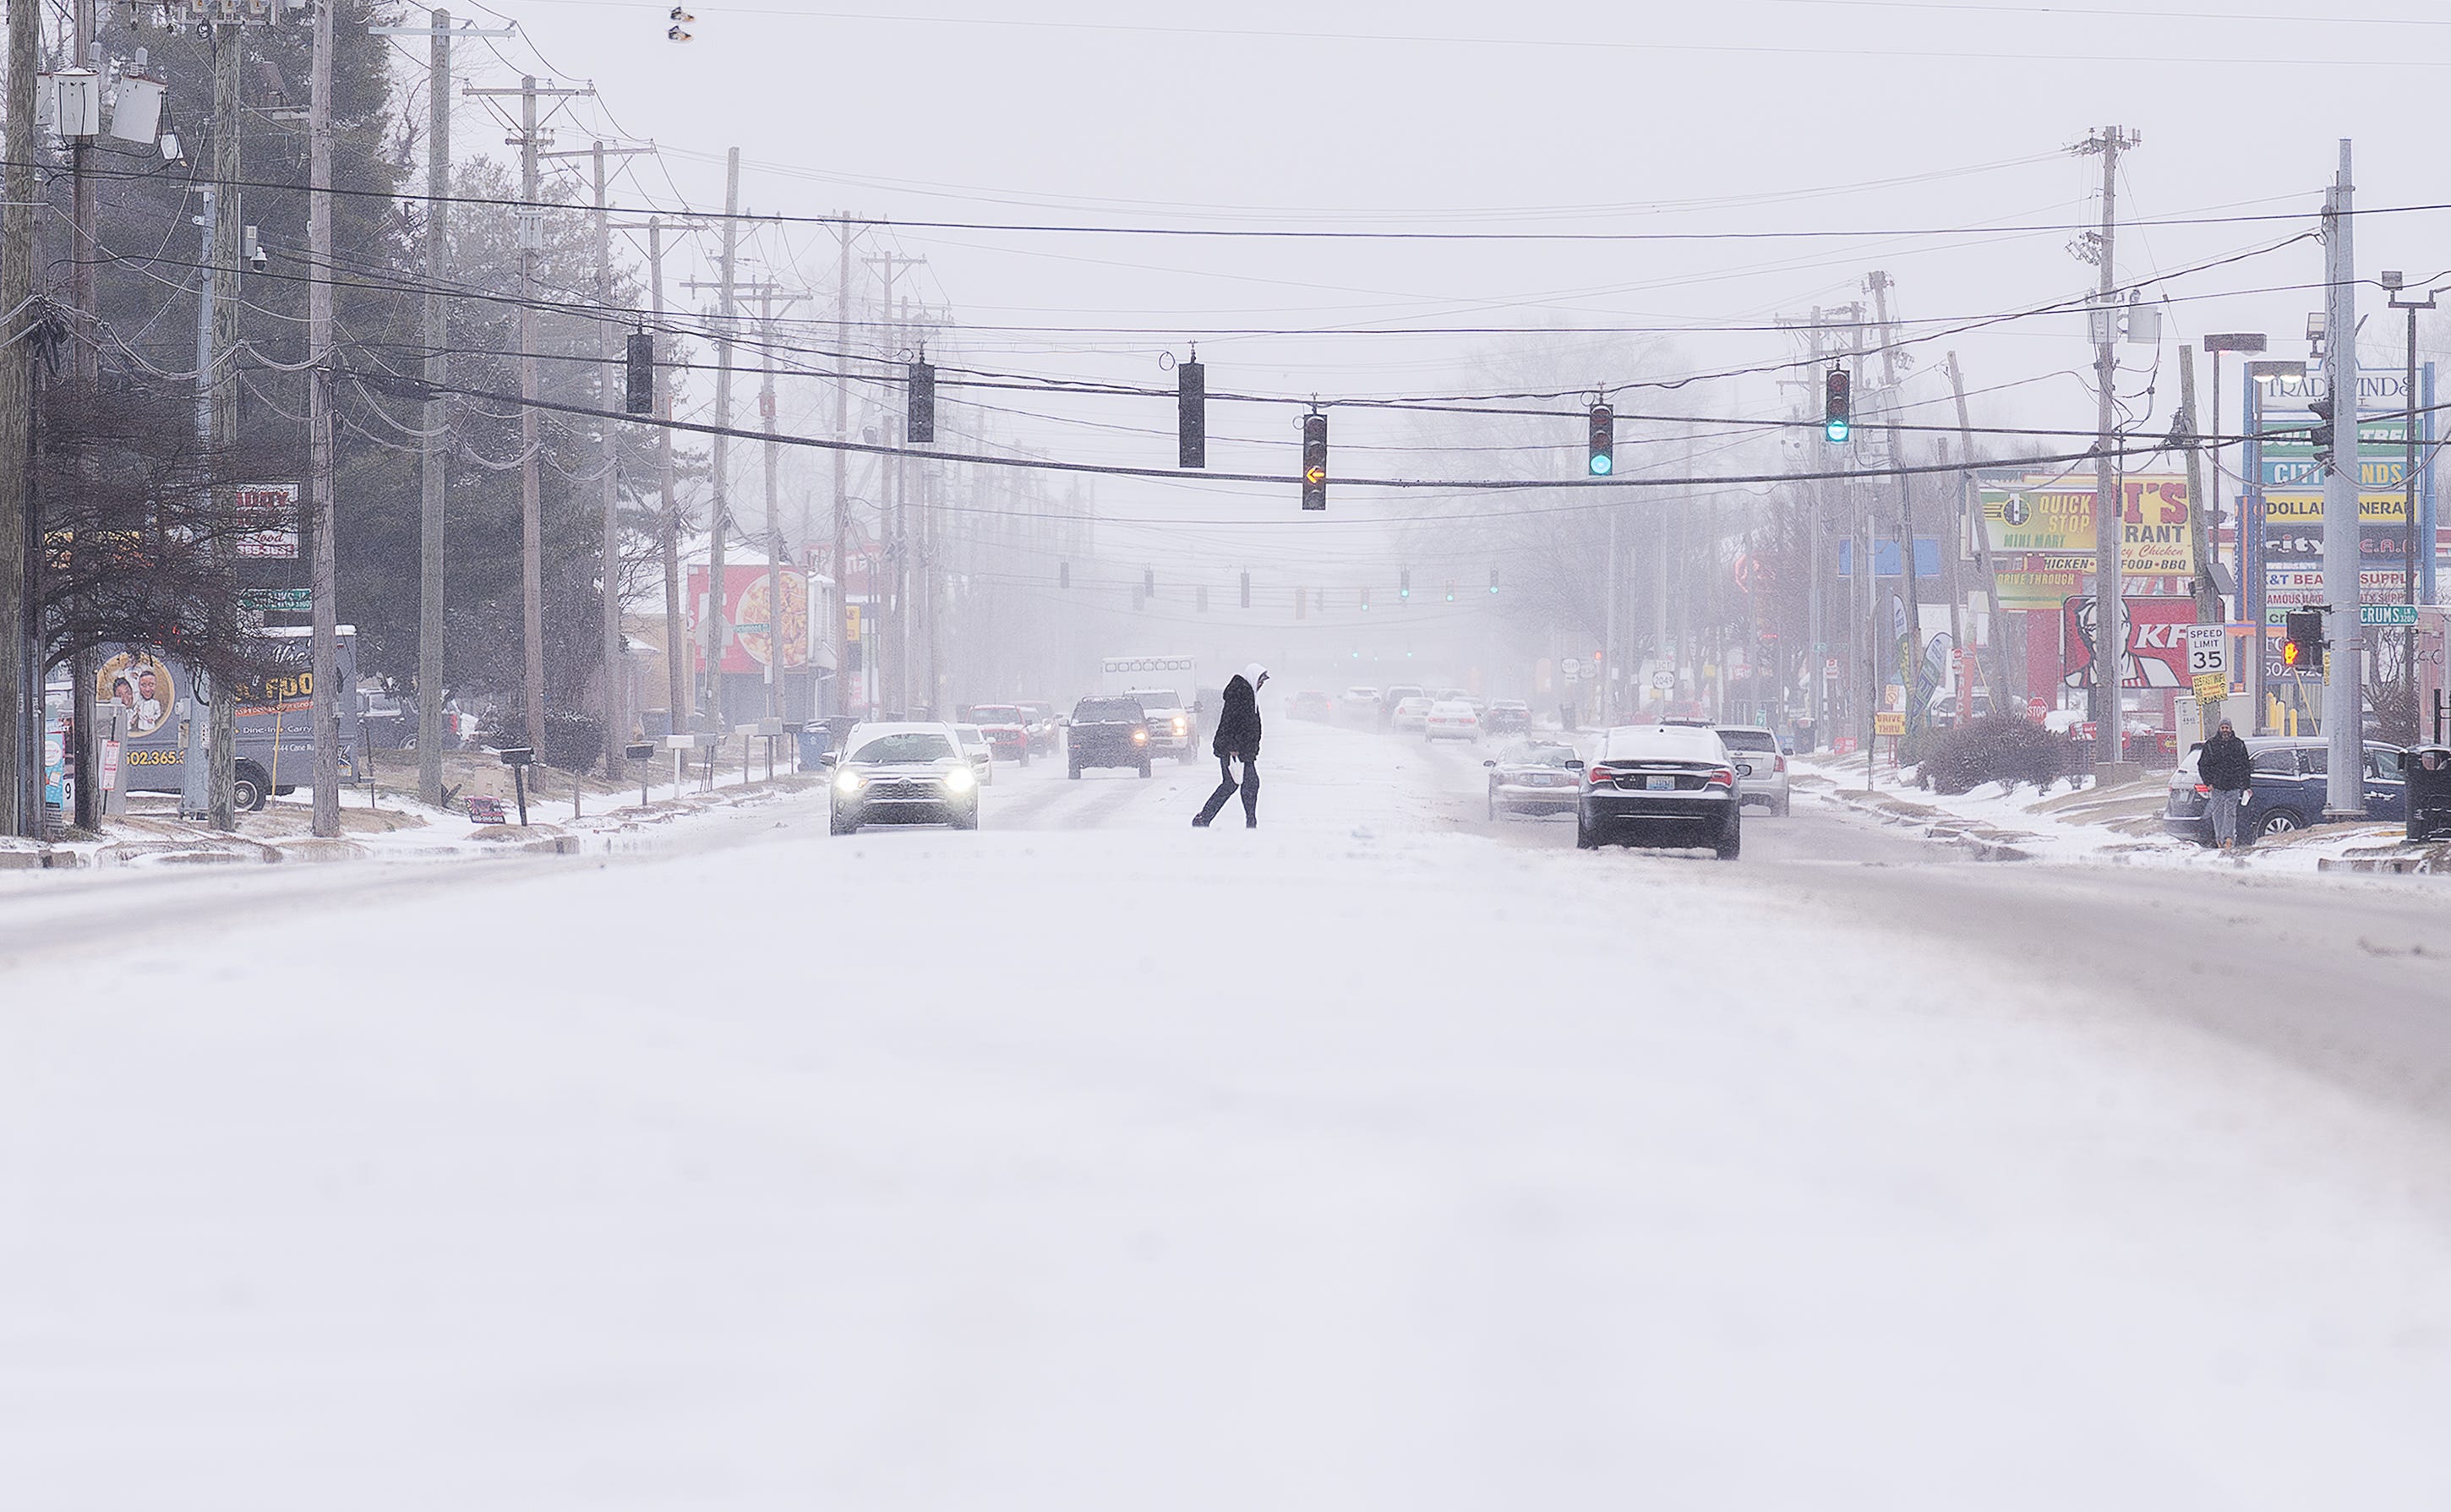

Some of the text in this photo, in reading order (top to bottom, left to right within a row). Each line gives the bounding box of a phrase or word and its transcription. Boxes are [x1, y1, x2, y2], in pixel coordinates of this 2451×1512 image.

[2361, 464, 2402, 483] NDS
[2039, 494, 2092, 515] QUICK
[2266, 502, 2408, 515] DOLLA NERA
[2049, 515, 2091, 533] STOP
[2003, 533, 2066, 548] MINI MART
[2138, 543, 2185, 558] Chicken
[2044, 559, 2089, 569] HICKEN
[2160, 559, 2187, 570] BBQ
[1997, 571, 2075, 586] DRIVE THROUGH
[2294, 574, 2323, 585] BEA
[2267, 594, 2302, 605] AMOUS
[2360, 606, 2399, 623] CRUMS
[2134, 623, 2188, 649] KF
[2190, 629, 2223, 639] SPEED
[2193, 640, 2219, 648] LIMIT
[2192, 651, 2223, 669] 35
[265, 672, 314, 699] FOO
[1655, 676, 1673, 685] 2049
[1876, 714, 1902, 723] DRIVE
[2028, 707, 2047, 718] STOP
[287, 725, 314, 734] Carry
[1878, 724, 1900, 733] THRU
